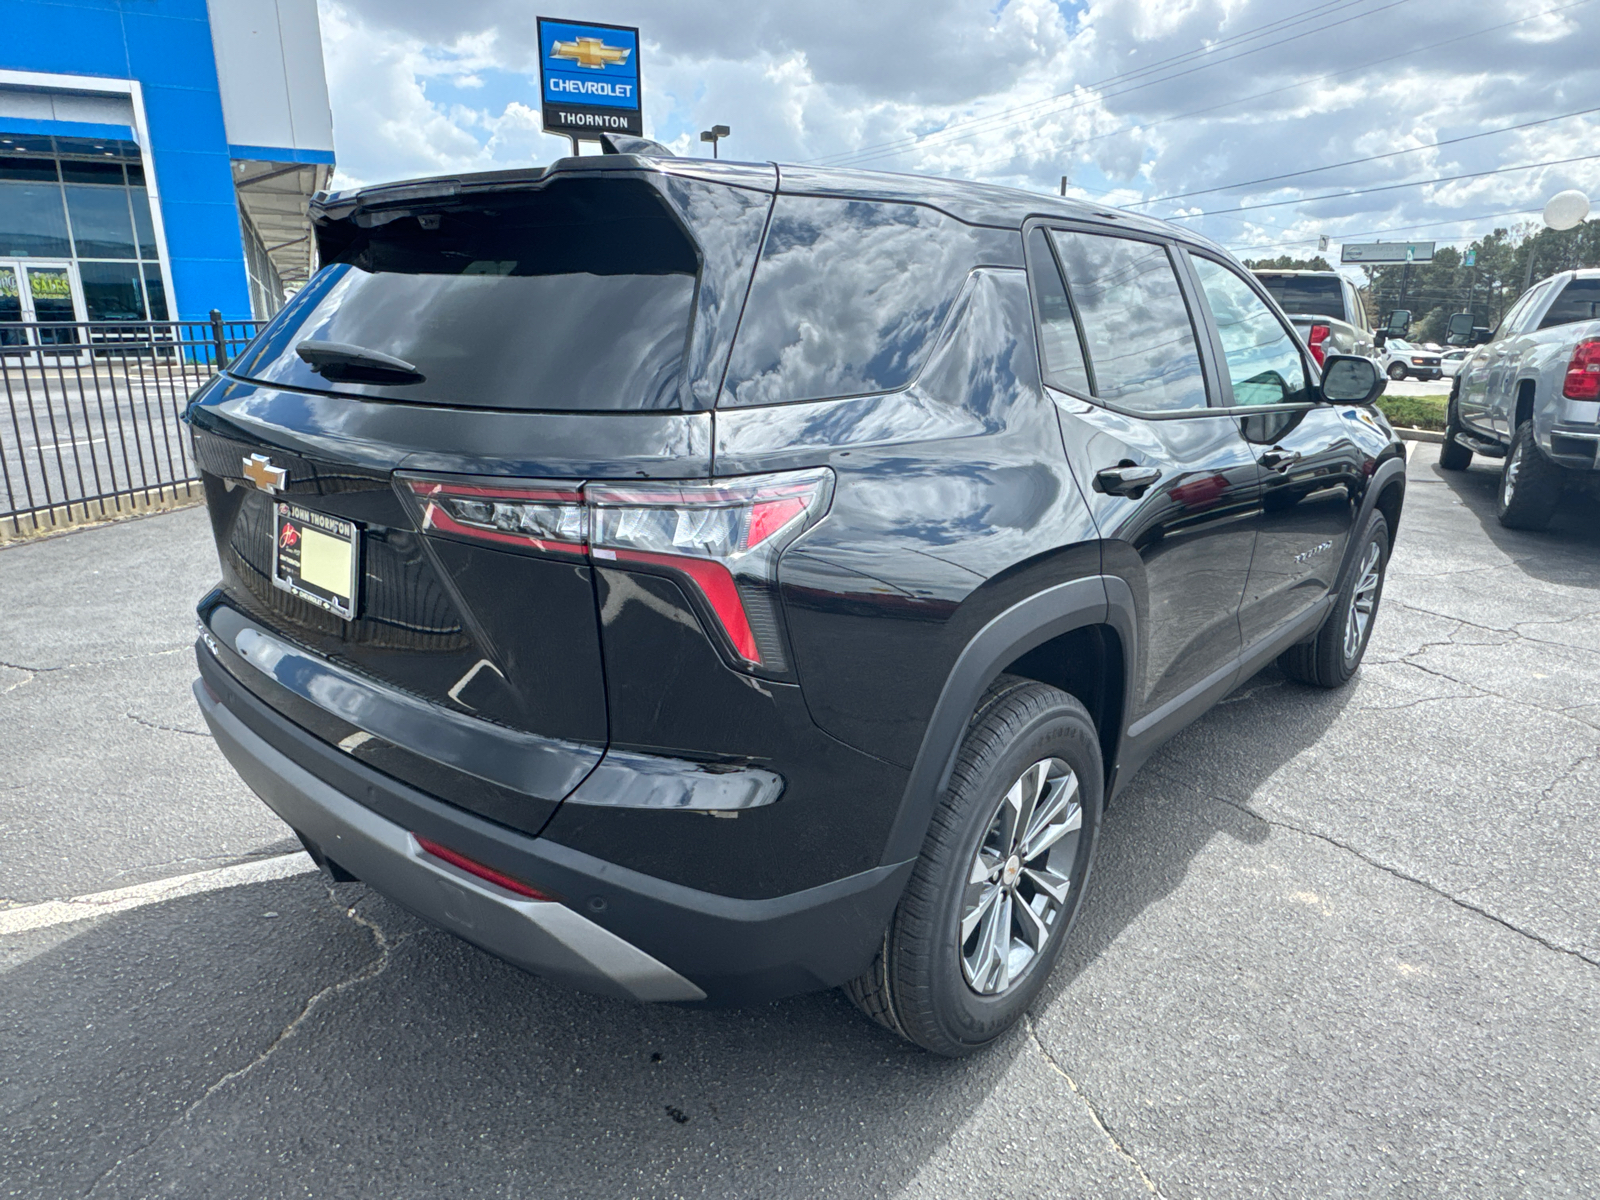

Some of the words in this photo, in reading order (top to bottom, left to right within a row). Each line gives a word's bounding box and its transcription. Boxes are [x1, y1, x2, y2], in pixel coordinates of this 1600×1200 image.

[549, 78, 633, 98] CHEVROLET
[559, 112, 628, 128] THORNTON
[33, 279, 70, 293] SALES
[291, 506, 310, 522] JOHN
